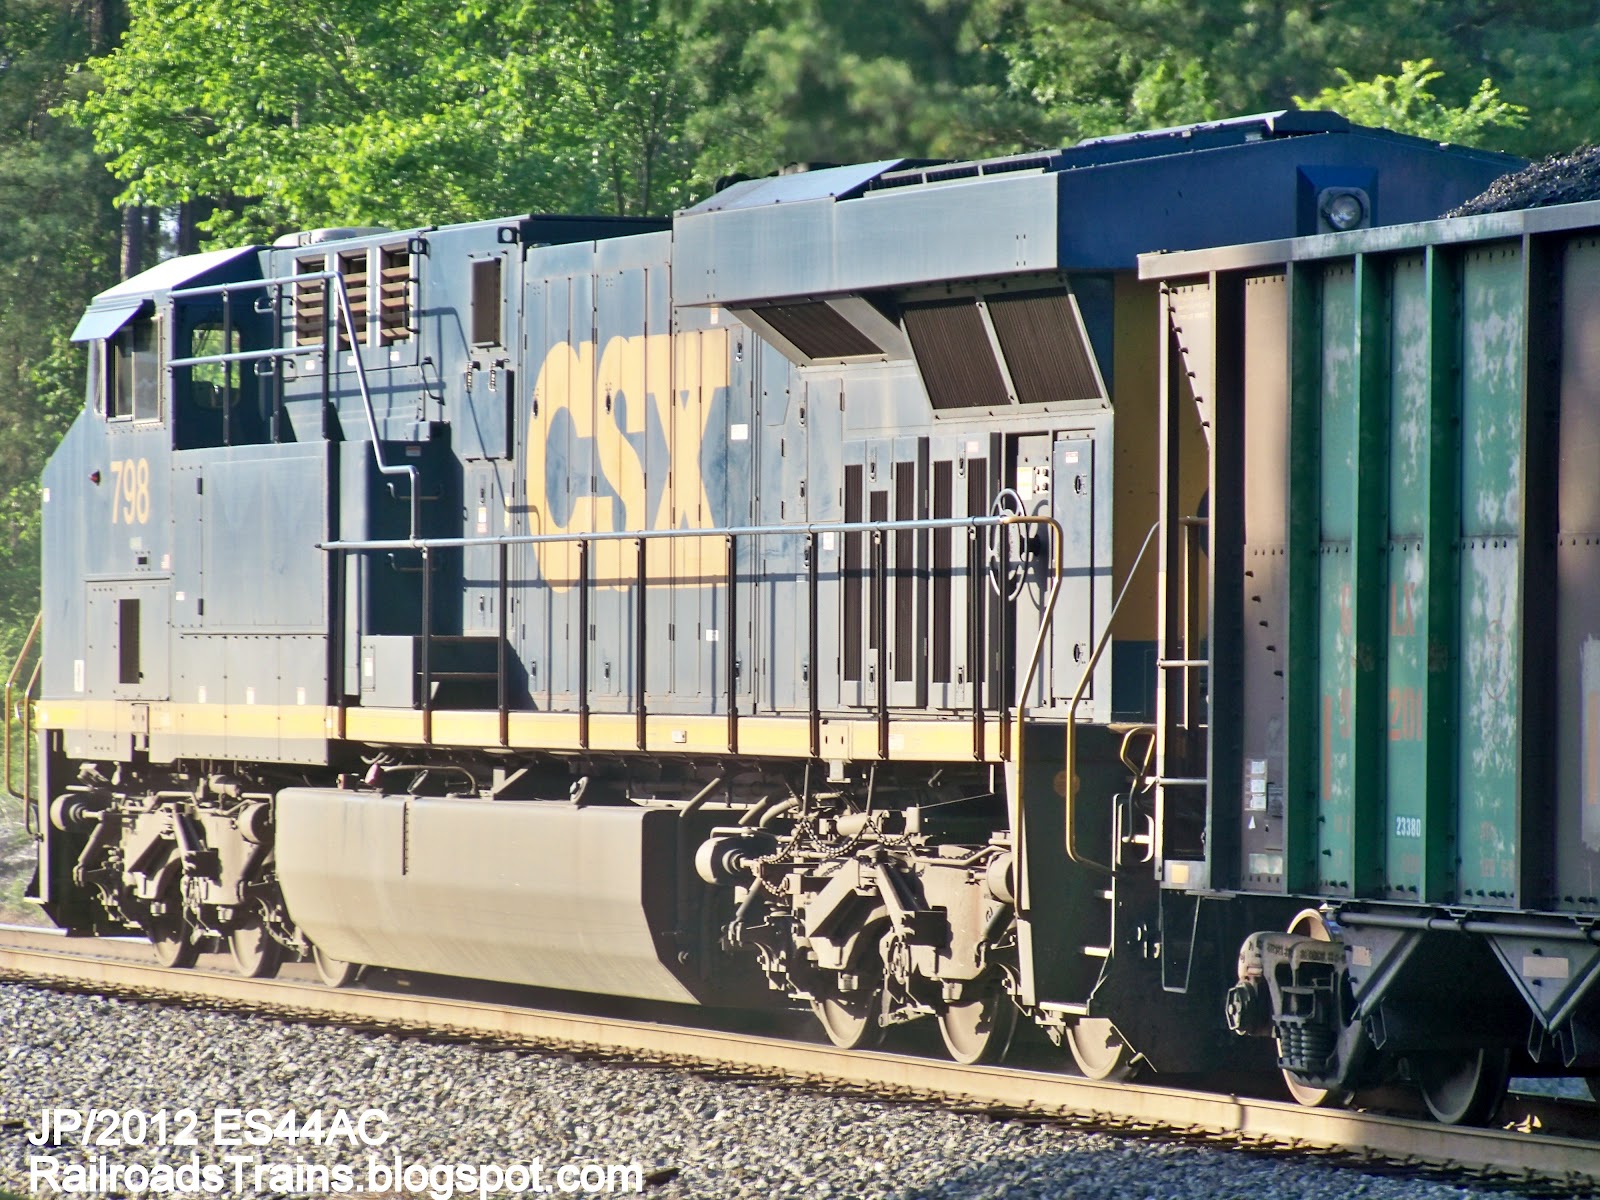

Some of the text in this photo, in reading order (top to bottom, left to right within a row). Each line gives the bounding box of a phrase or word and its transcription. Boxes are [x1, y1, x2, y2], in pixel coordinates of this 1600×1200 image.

[526, 328, 731, 594] CSX
[110, 458, 149, 525] 798
[1388, 687, 1423, 741] 201
[1396, 816, 1421, 837] 23380
